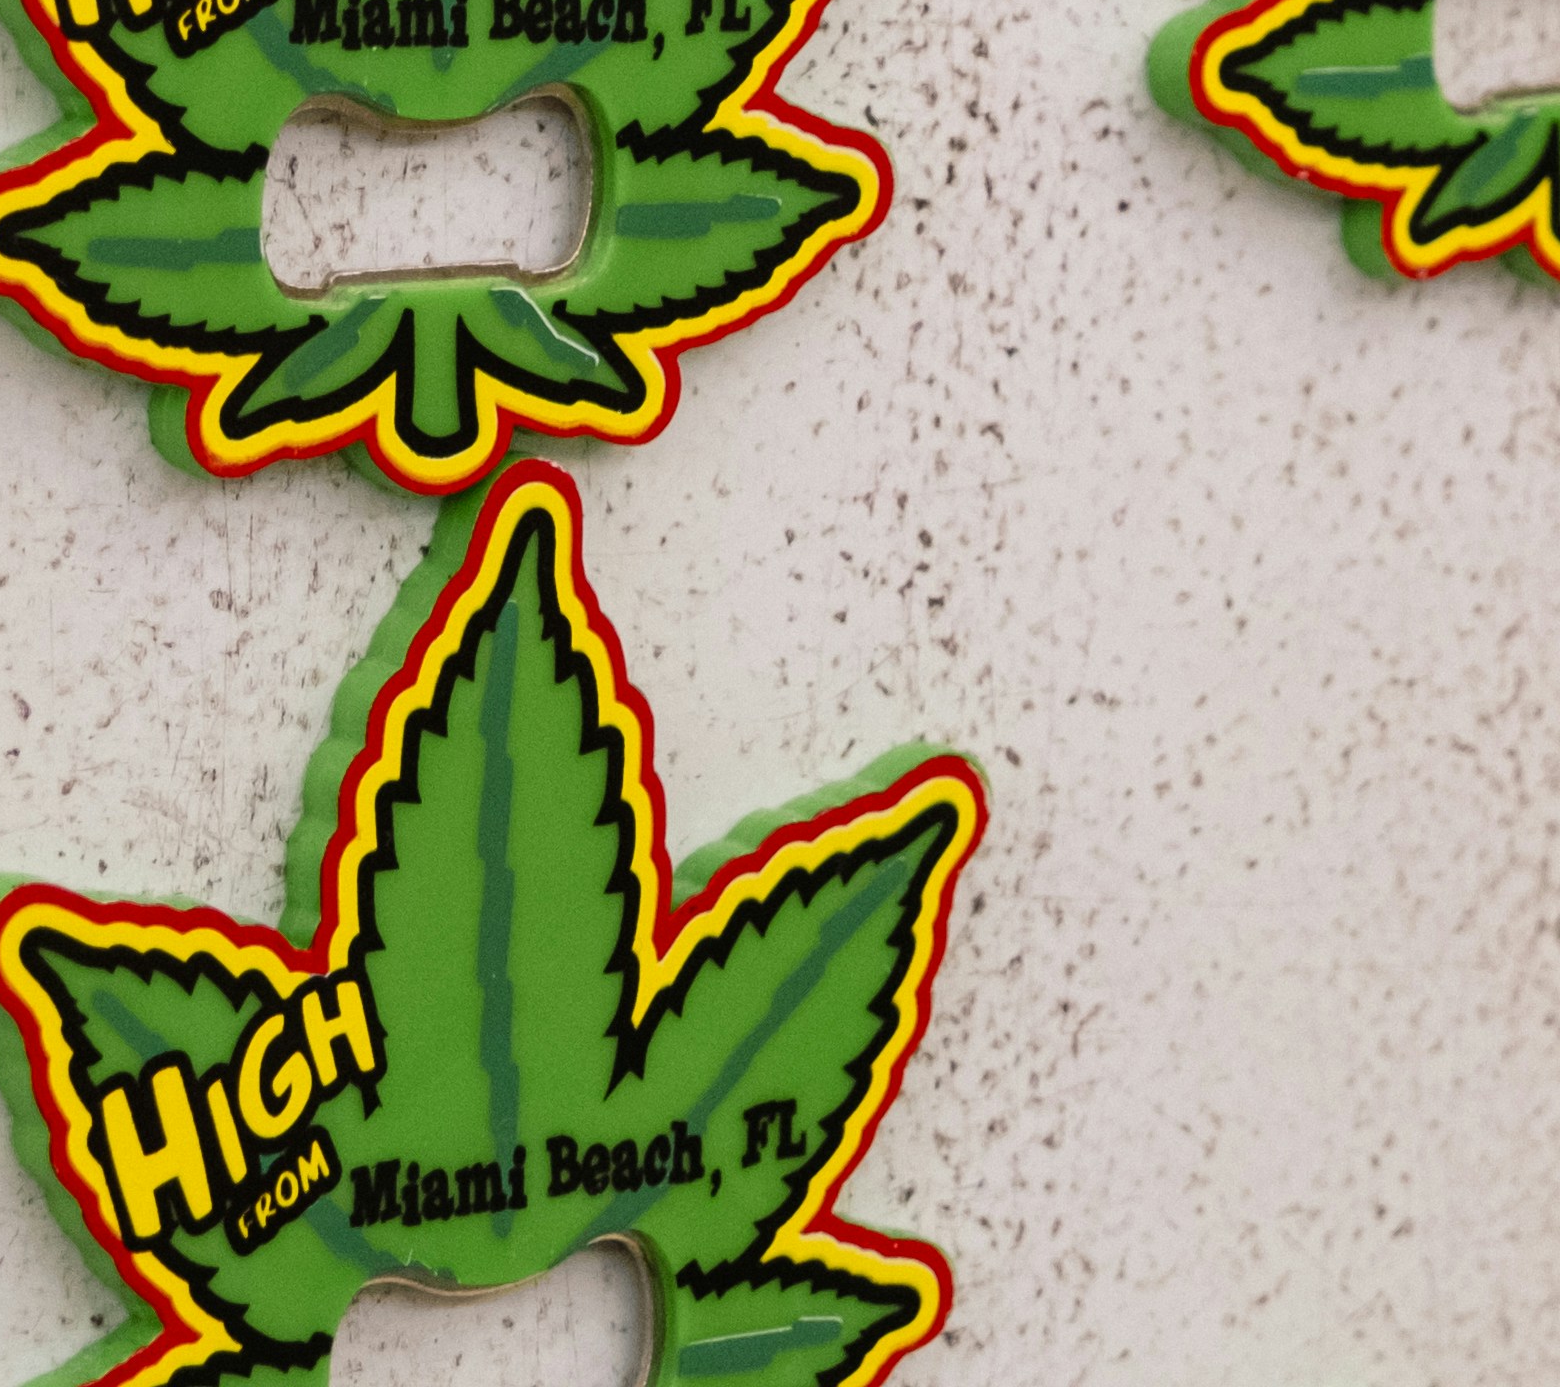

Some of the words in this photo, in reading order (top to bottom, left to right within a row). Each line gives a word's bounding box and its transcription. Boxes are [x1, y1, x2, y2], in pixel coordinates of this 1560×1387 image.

[101, 980, 375, 1238] HIGH
[349, 1145, 527, 1229] Miami
[546, 1120, 722, 1198] Beach,
[740, 1099, 808, 1168] FL
[238, 1139, 332, 1239] FROM
